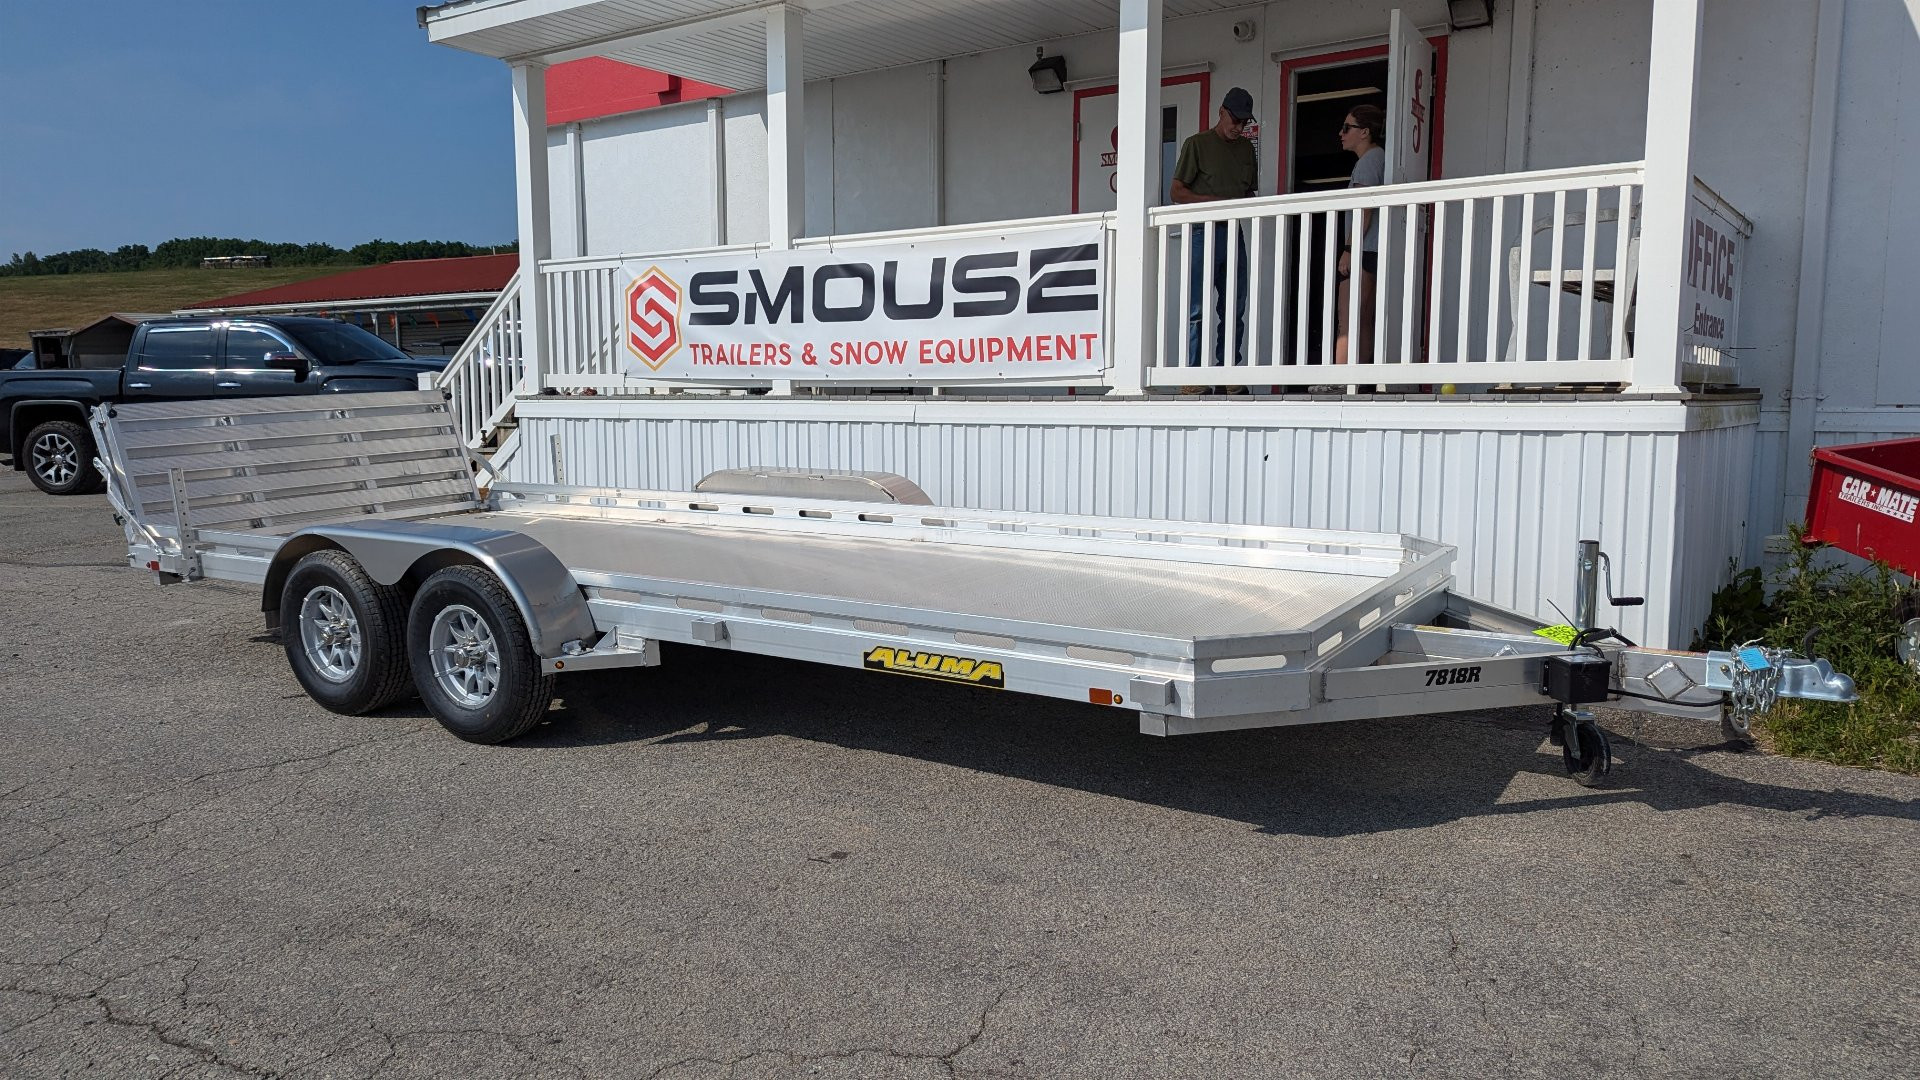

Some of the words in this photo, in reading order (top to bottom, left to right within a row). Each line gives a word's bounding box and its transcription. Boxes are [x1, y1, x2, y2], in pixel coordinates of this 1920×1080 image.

[688, 243, 1098, 326] SMOUSE
[1693, 302, 1725, 340] Entrance
[689, 343, 792, 366] TRAILERS
[801, 344, 818, 365] &
[829, 339, 908, 365] SNOW
[919, 333, 1098, 364] EQUIPMENT
[1876, 487, 1920, 517] MATE
[866, 646, 1002, 681] ALUMA
[1425, 666, 1482, 687] 7818R
